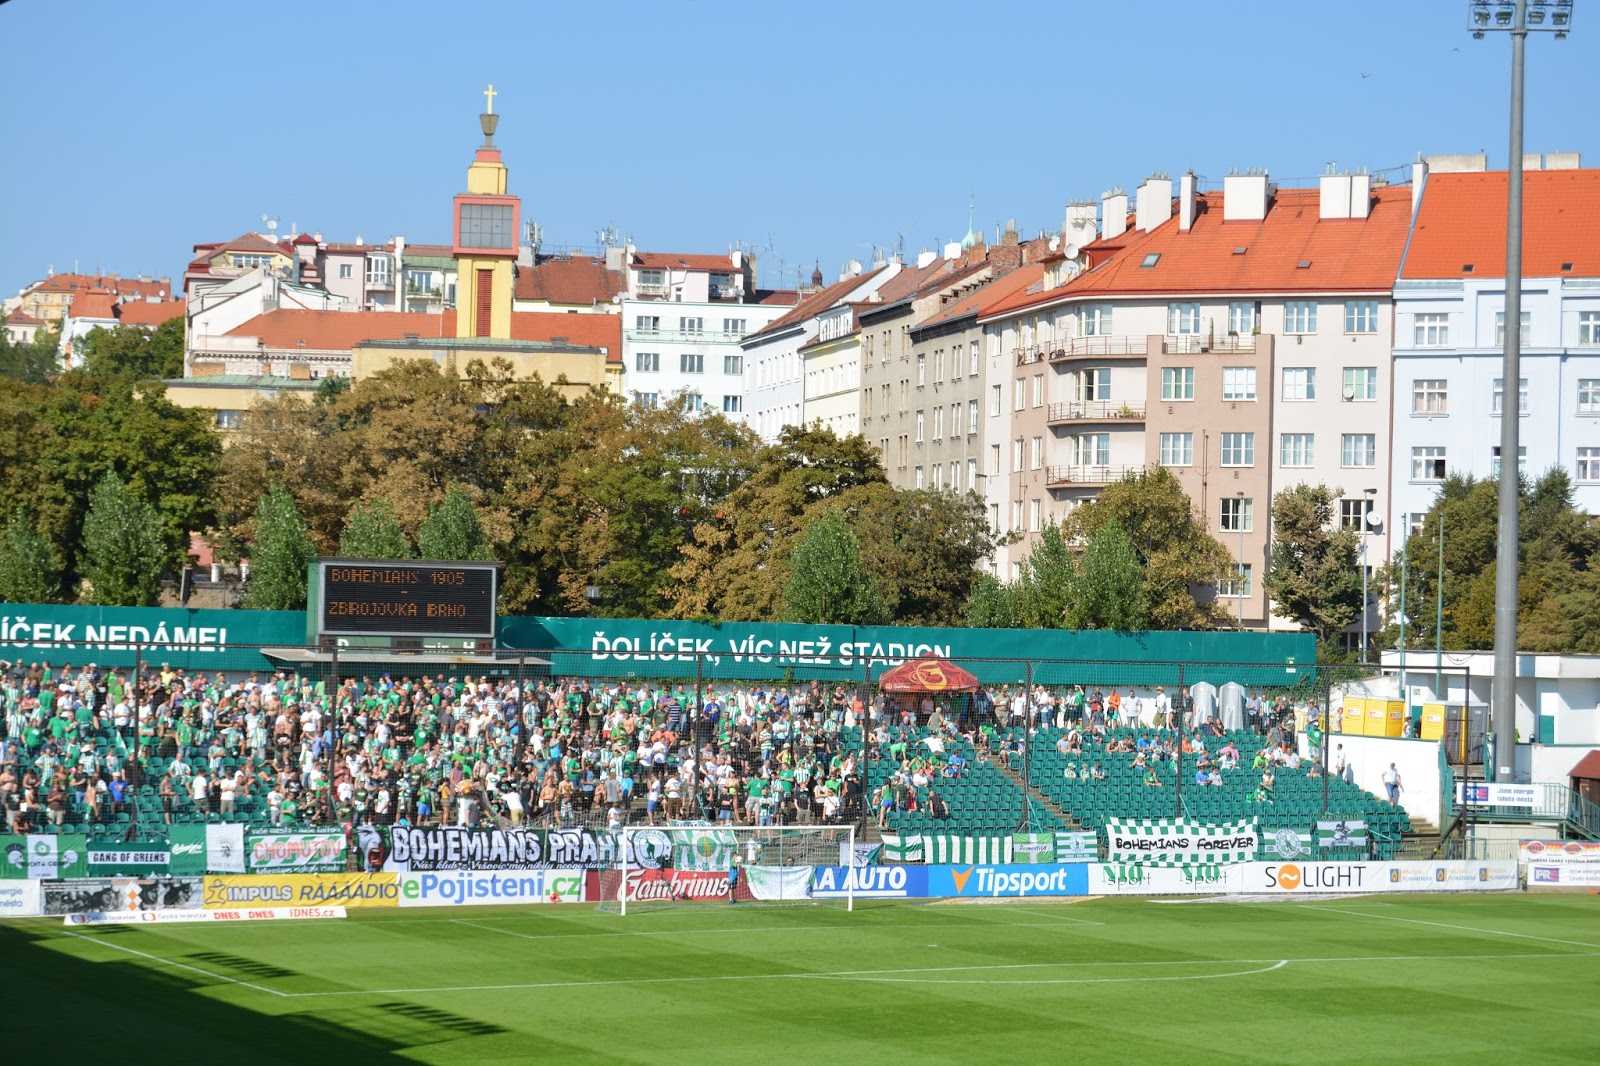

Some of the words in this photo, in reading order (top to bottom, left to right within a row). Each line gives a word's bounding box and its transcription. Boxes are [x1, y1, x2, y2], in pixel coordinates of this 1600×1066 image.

[331, 568, 419, 584] BOHEMIANS
[430, 571, 465, 585] 1905
[328, 601, 418, 617] ZBROJOVKA
[426, 603, 466, 617] BRNO
[85, 621, 227, 652] NEDÁME!
[729, 635, 774, 663] VÍC
[779, 636, 832, 664] NEŽ
[253, 839, 342, 860] CHOMUTOV
[392, 827, 541, 862] BOHEMIANS
[548, 831, 634, 863] PRAHA
[1115, 838, 1190, 851] BOHEMIANS
[1196, 837, 1254, 850] FOREVER
[93, 852, 117, 863] GANG
[120, 852, 131, 862] OF
[133, 852, 165, 862] GREENS
[617, 868, 729, 901] Gambrinus
[841, 866, 907, 890] AUTO
[976, 867, 1067, 896] Tipsport
[1535, 868, 1558, 881] PRE
[226, 885, 293, 901] IMPULS
[300, 880, 398, 901] RÁÁÁÁDIO
[403, 872, 582, 904] ePojisteni.cz
[213, 911, 241, 920] DNES
[248, 911, 275, 919] DNES
[289, 908, 335, 917] iDNES.cz
